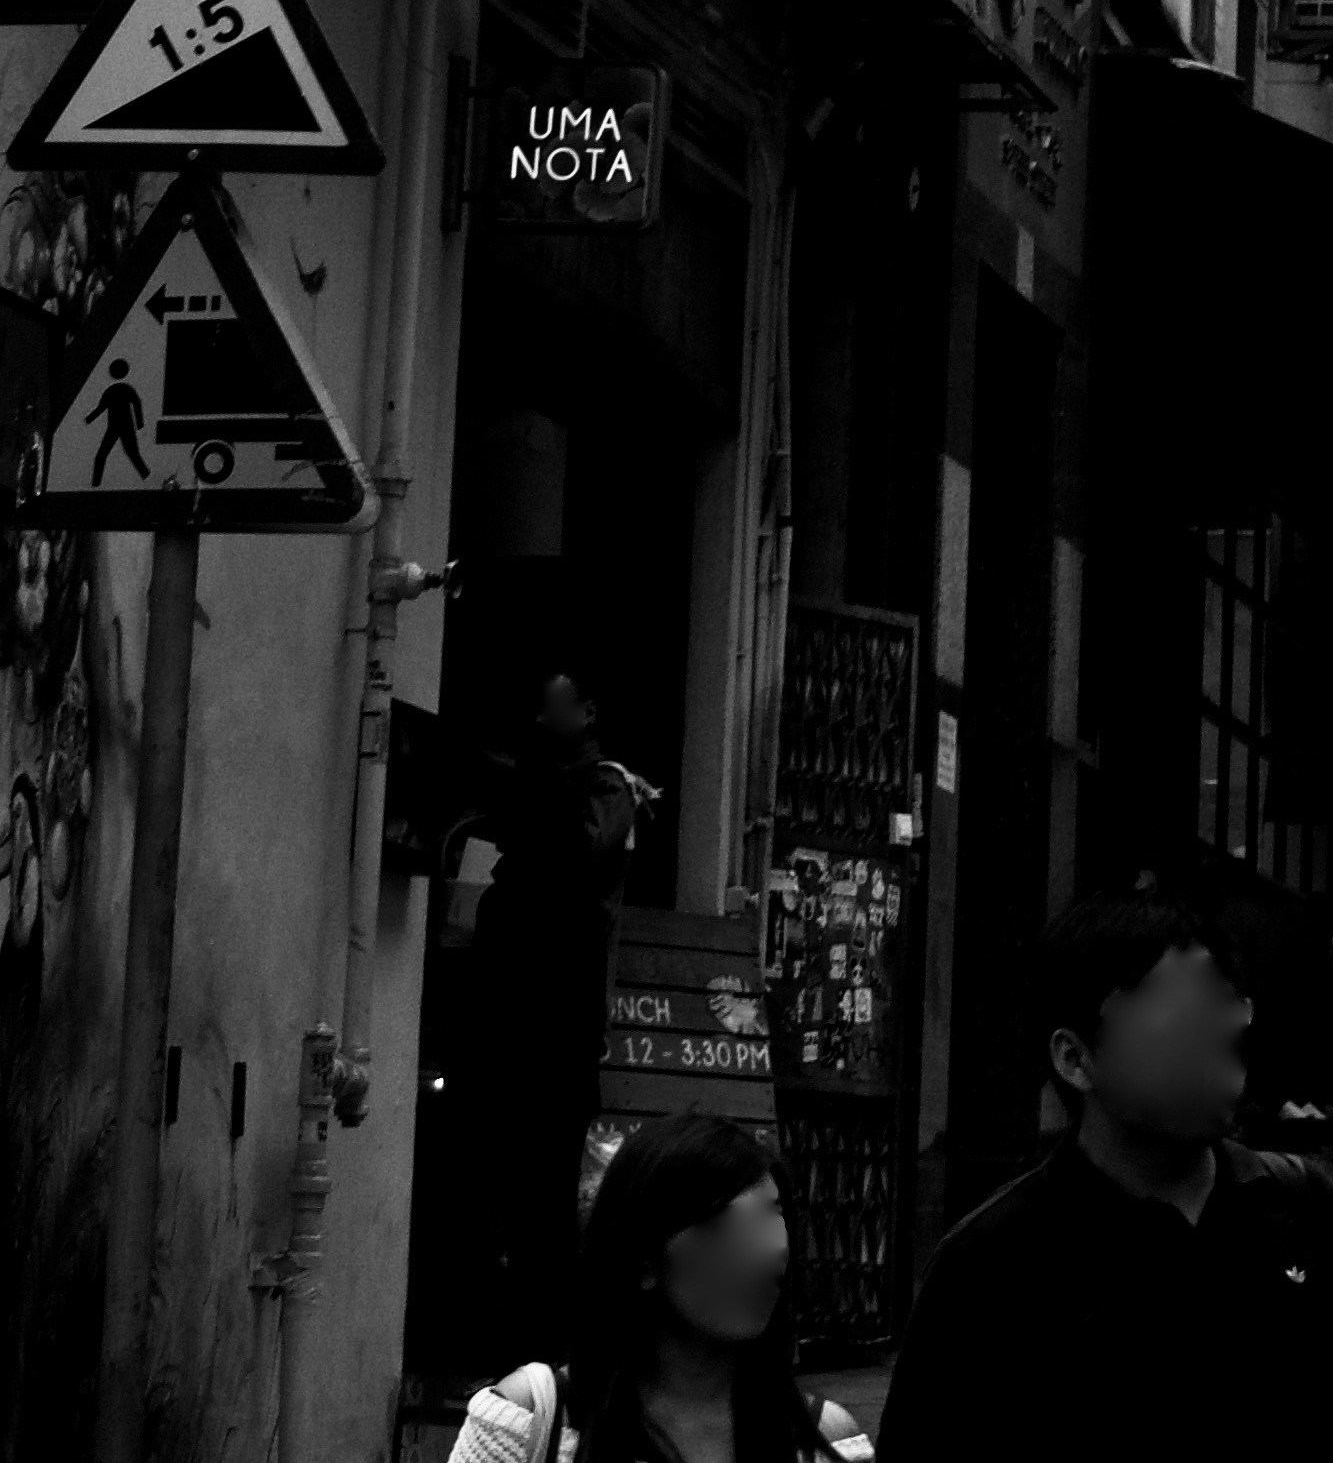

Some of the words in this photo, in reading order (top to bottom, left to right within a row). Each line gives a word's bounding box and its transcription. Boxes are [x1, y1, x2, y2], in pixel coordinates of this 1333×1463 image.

[528, 105, 621, 142] UMA
[510, 145, 633, 182] NOTA
[625, 1037, 655, 1065] 12
[681, 1038, 732, 1068] 3:30
[735, 1042, 772, 1072] PM
